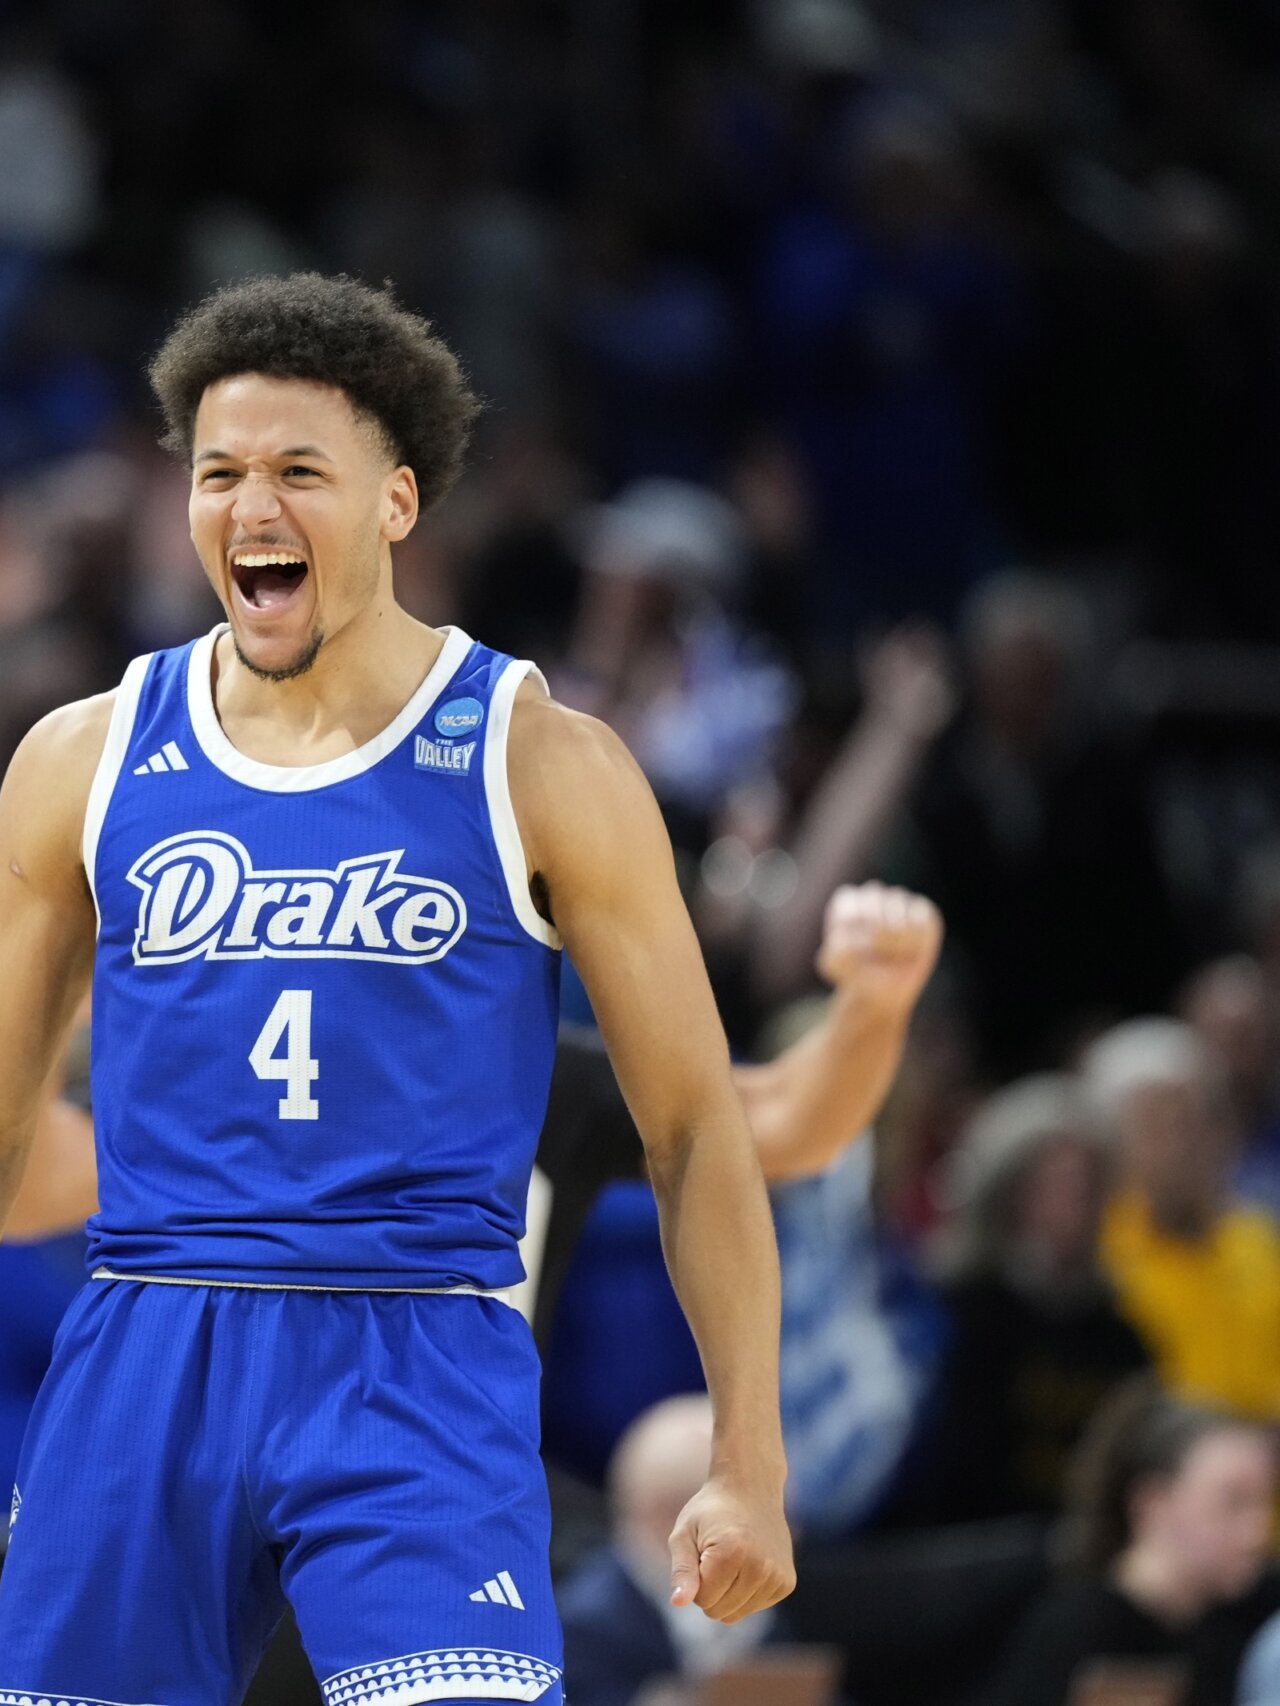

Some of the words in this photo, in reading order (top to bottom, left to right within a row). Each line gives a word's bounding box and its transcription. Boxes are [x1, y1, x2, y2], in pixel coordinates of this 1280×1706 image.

[414, 734, 477, 770] VALLEY
[440, 715, 479, 726] NCAA
[125, 829, 468, 966] Drake
[247, 989, 320, 1120] 4
